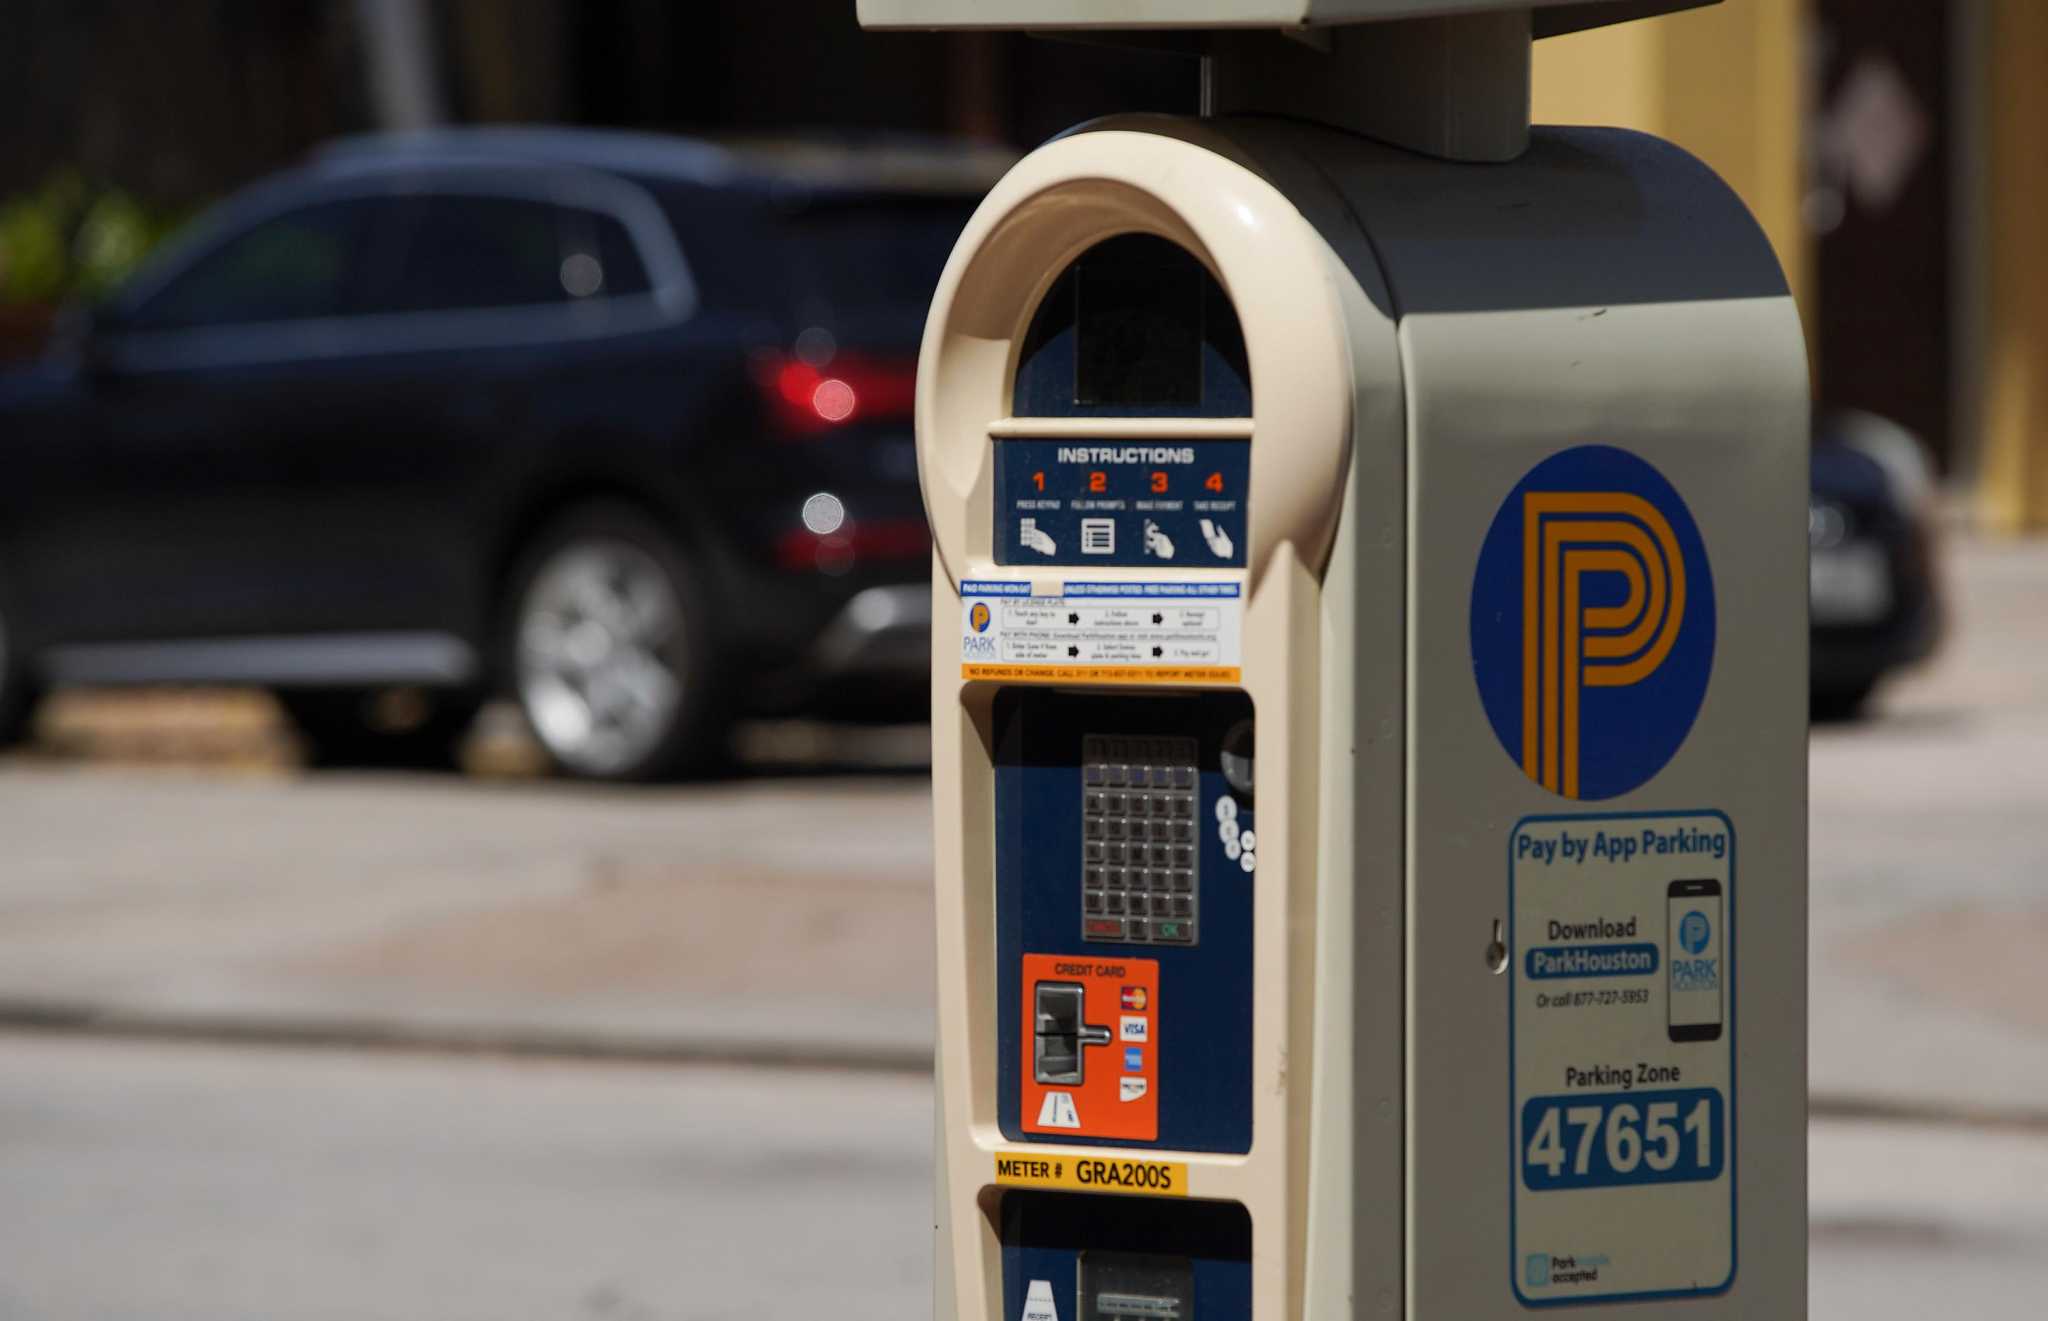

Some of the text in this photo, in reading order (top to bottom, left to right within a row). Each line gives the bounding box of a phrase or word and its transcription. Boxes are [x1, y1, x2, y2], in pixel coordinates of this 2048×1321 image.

[1057, 447, 1195, 465] INSTRUCTIONS
[1032, 471, 1045, 493] 1
[1088, 471, 1107, 493] 2
[1151, 471, 1169, 493] 3
[1204, 472, 1224, 493] 4
[1517, 828, 1726, 865] Pay by App Parking
[1548, 916, 1637, 941] Download
[1055, 962, 1126, 978] CREDIT CARD
[1533, 950, 1651, 974] ParkHouston
[1671, 960, 1717, 978] PARK
[1536, 993, 1550, 1008] Or
[1551, 990, 1571, 1008] call
[1124, 1023, 1145, 1035] VISA
[1565, 1063, 1681, 1089] Parking Zone
[1526, 1097, 1711, 1177] 47651
[997, 1160, 1172, 1189] METER # GRA200S
[1552, 1270, 1598, 1284] accepted
